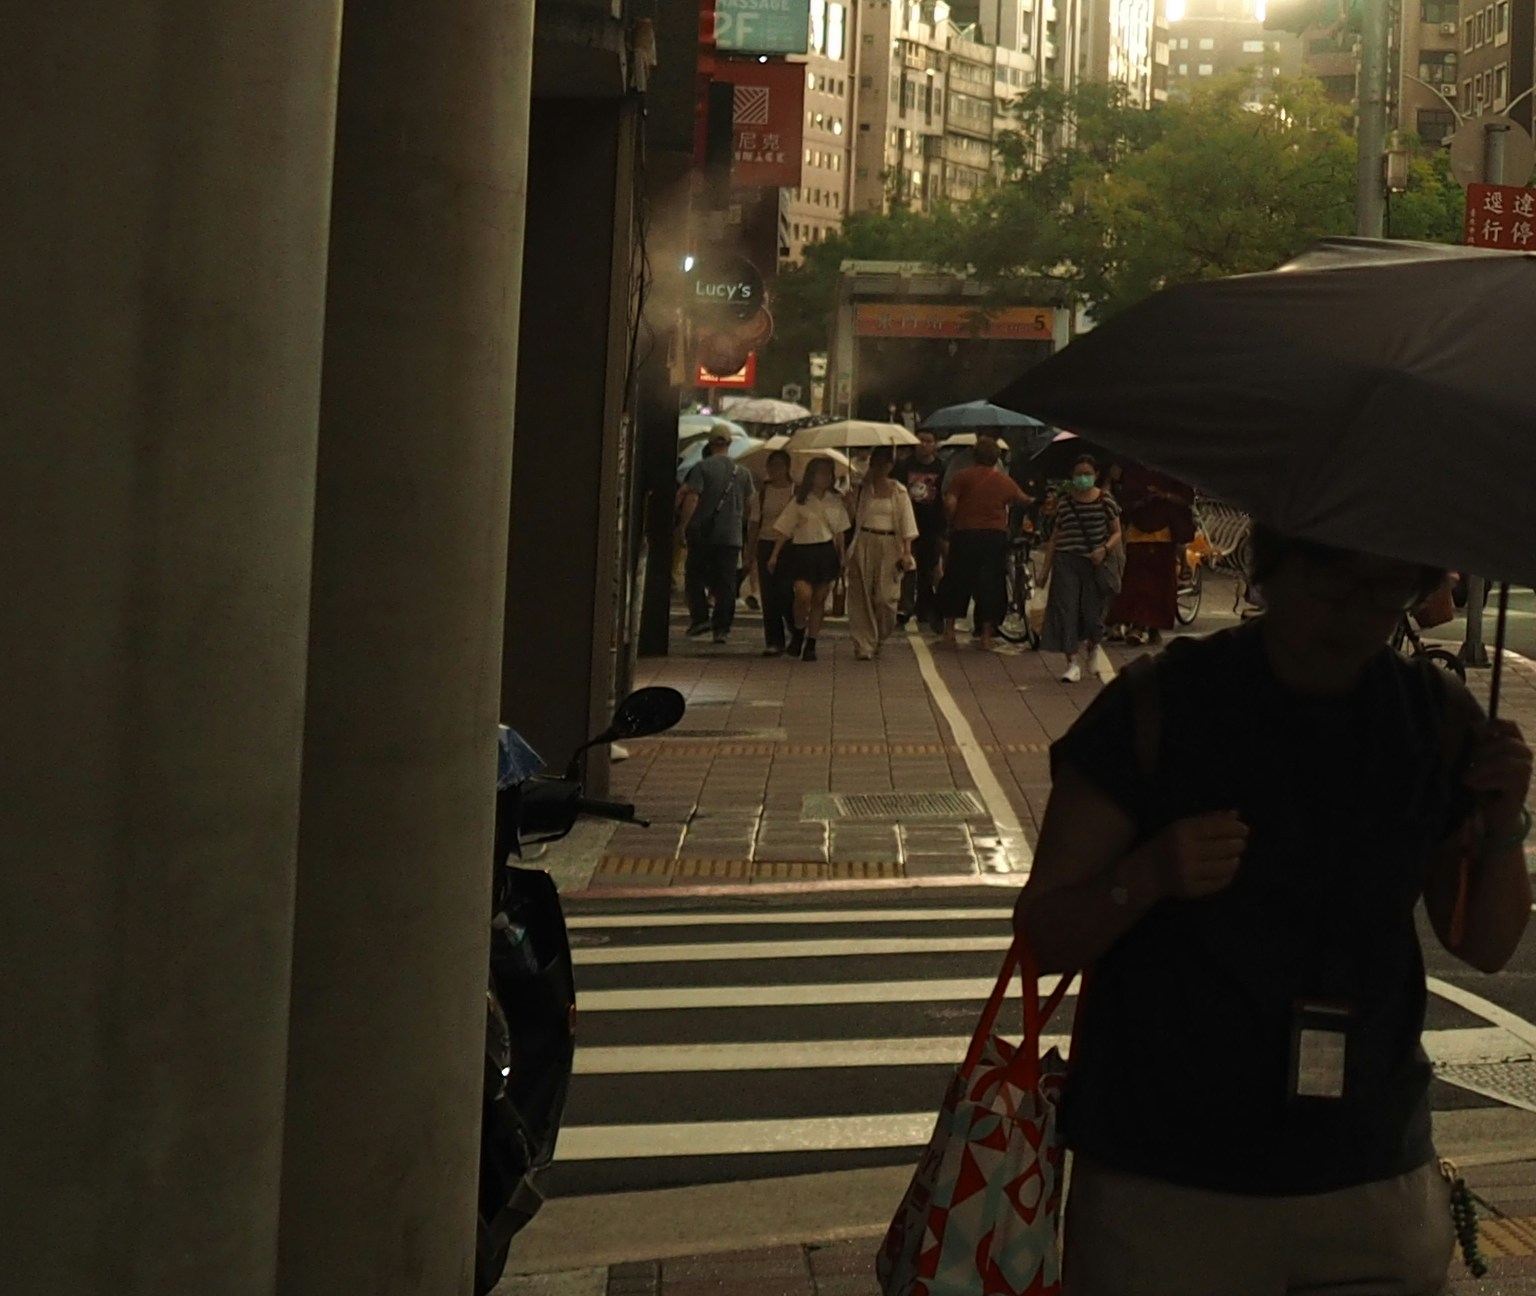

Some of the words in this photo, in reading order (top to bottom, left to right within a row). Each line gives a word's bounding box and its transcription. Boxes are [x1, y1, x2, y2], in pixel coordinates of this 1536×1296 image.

[714, 11, 760, 49] 2F
[695, 281, 752, 300] Lucy's
[1033, 315, 1045, 331] 5
